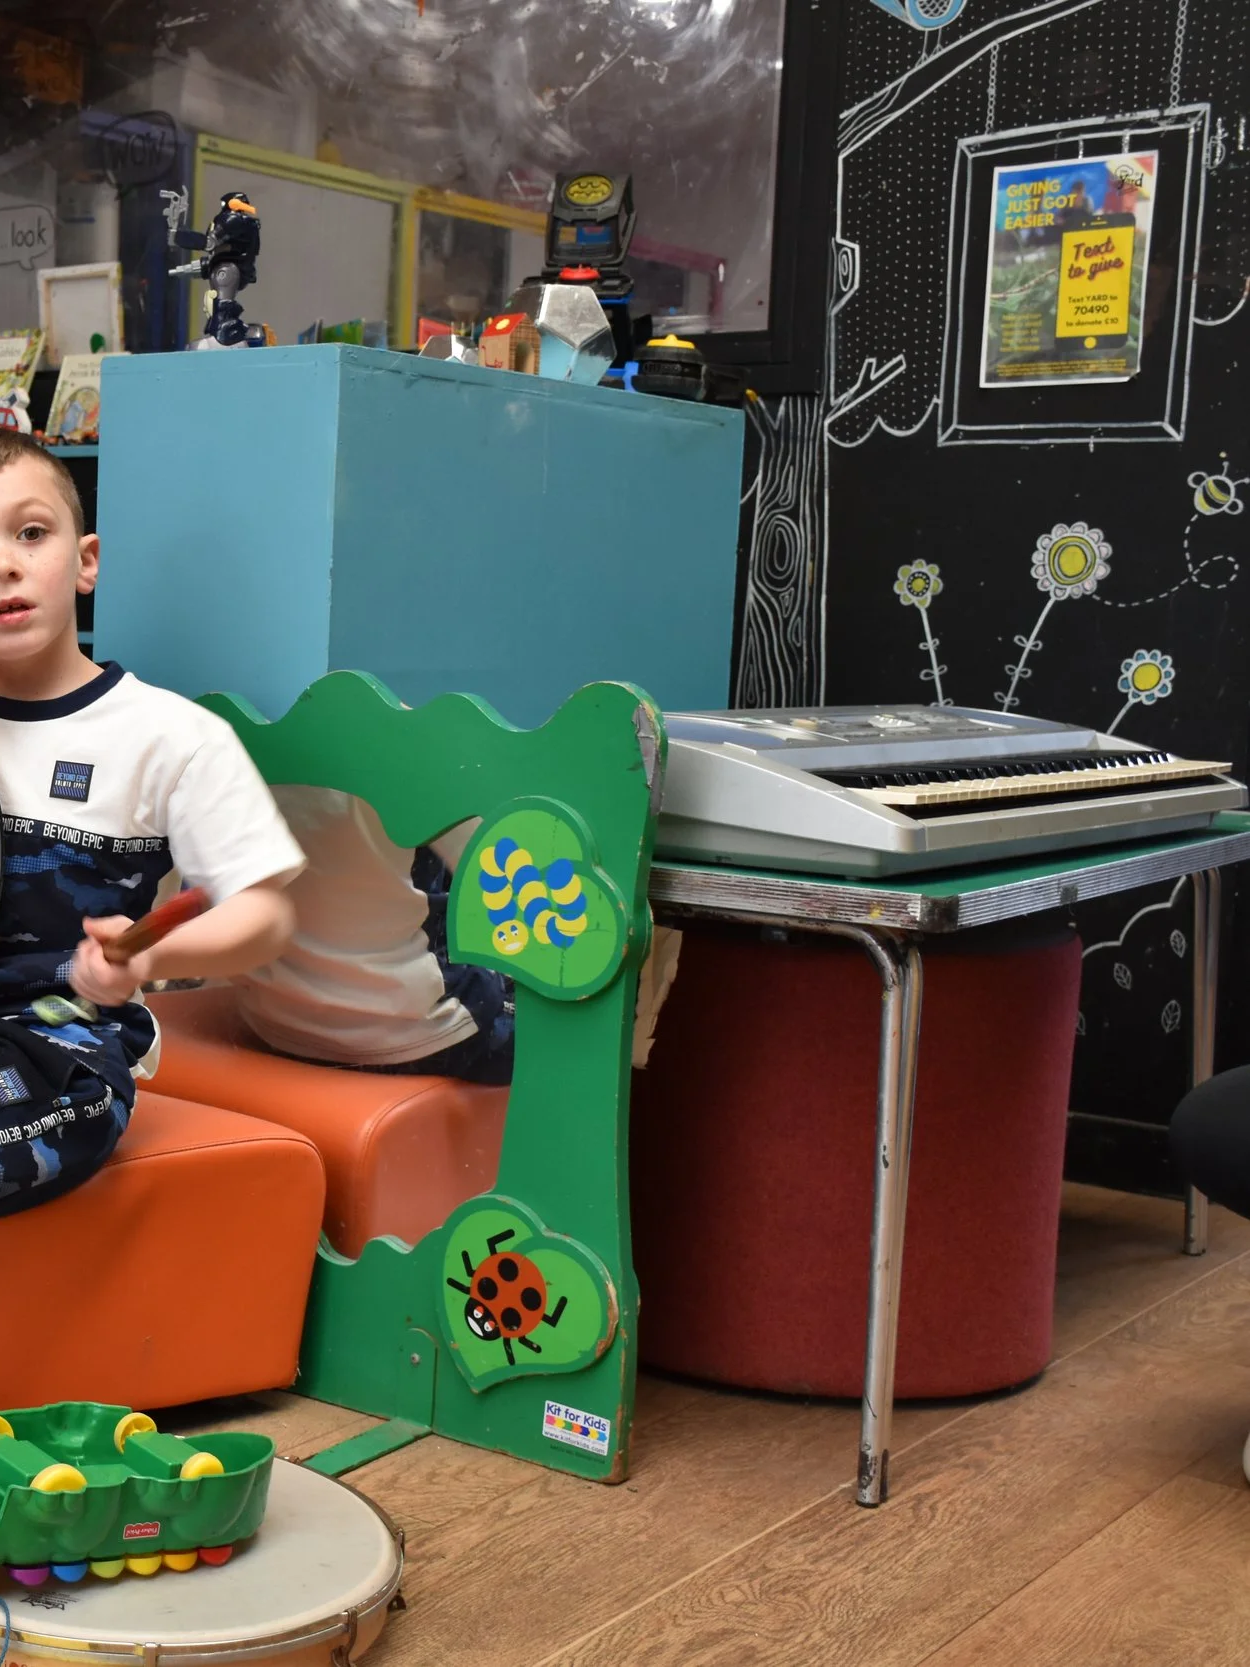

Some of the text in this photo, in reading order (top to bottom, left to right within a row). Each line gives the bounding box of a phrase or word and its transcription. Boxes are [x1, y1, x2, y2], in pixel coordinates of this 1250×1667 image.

[1006, 178, 1061, 198] GIVING
[1005, 193, 1078, 214] JUST GOT
[1004, 212, 1055, 230] EASIER
[11, 217, 47, 247] look
[1073, 236, 1115, 262] Text
[1068, 256, 1125, 281] to give
[1068, 296, 1085, 304] Text
[1086, 294, 1108, 303] YARD
[1074, 304, 1110, 316] 70490
[56, 772, 88, 783] BEYOND EPIC
[14, 818, 35, 834] EPIC
[43, 823, 105, 850] BEYOND EPIC
[112, 838, 163, 854] BEYOND EPIC
[84, 1101, 104, 1119] EPIC
[23, 1108, 76, 1139] BEYOND EPIC
[546, 1403, 607, 1431] Kit for Kids
